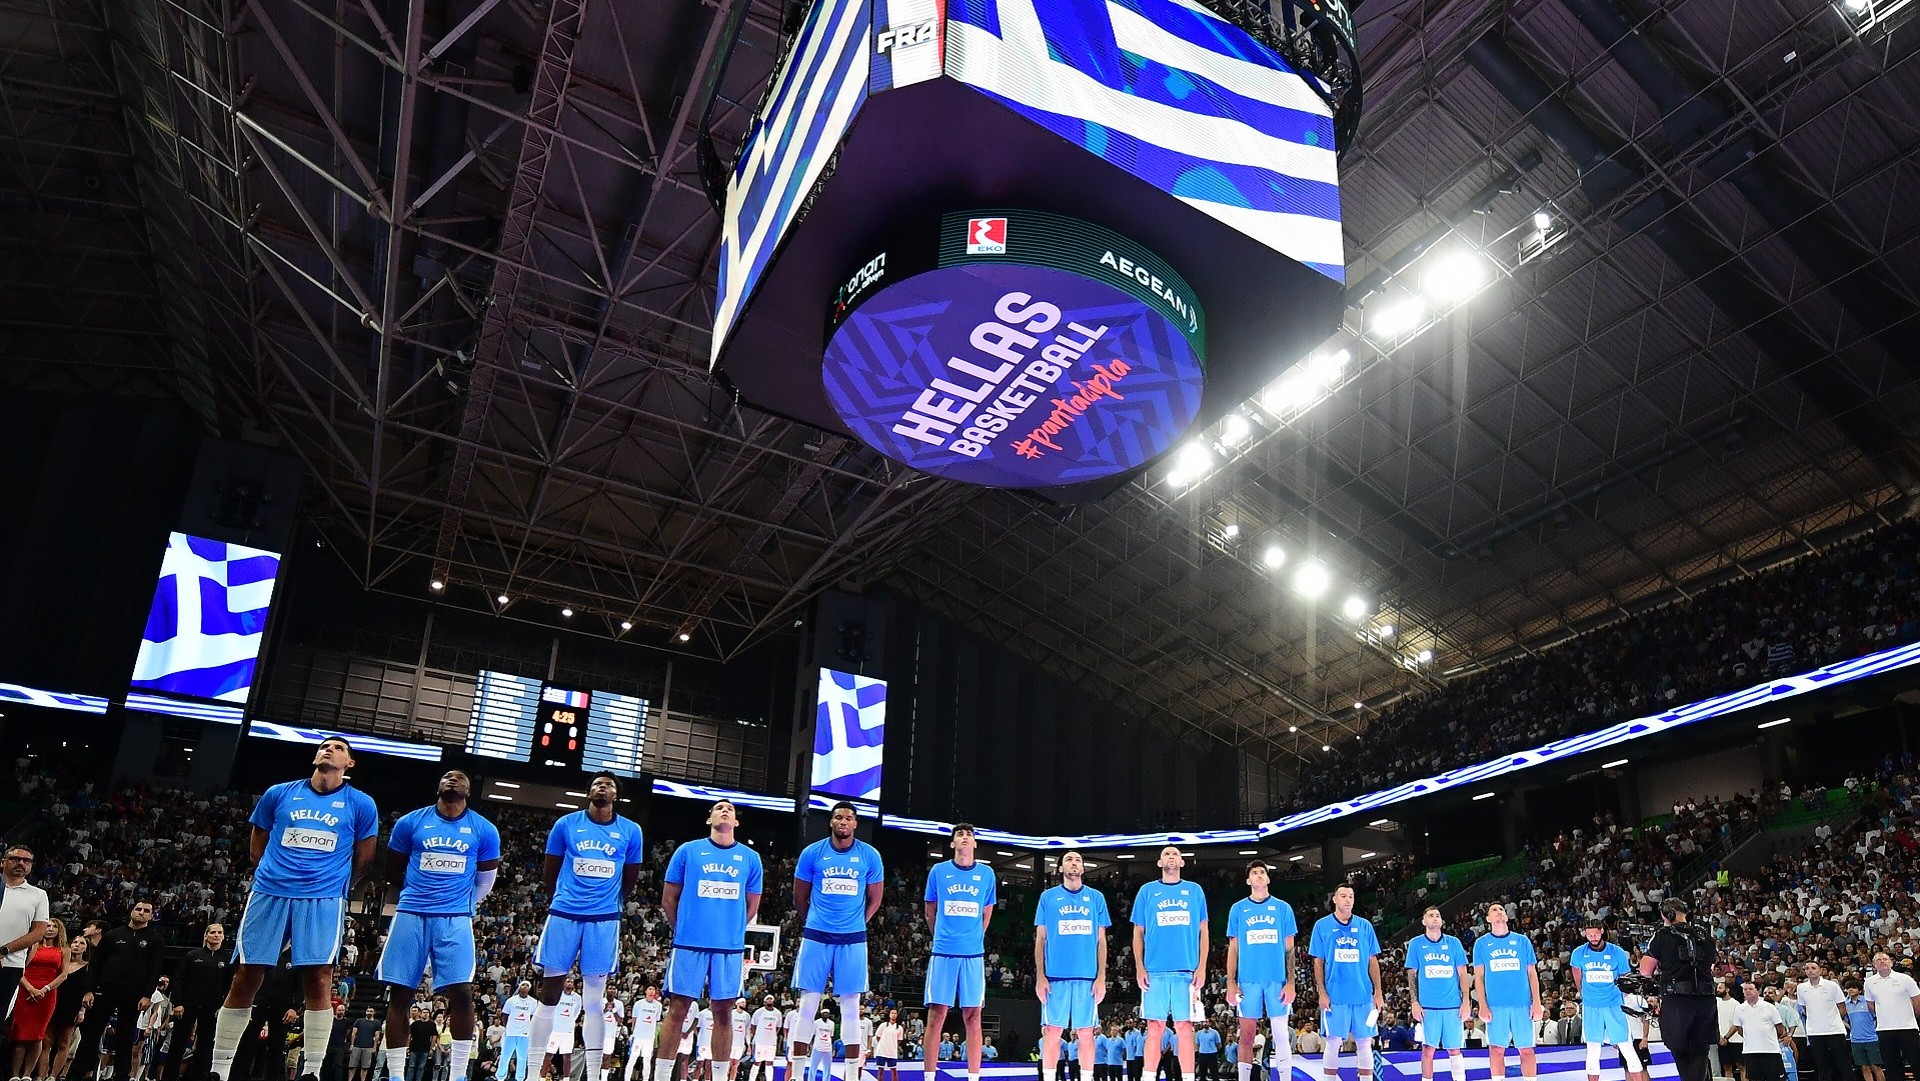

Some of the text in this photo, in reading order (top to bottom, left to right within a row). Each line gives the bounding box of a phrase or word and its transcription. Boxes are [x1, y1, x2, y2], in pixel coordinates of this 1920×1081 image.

[877, 19, 937, 54] FRA
[1099, 250, 1187, 320] AEGEAN
[892, 291, 1062, 447] HELLAS
[948, 321, 1109, 458] BASKETBALL
[552, 710, 575, 724] 4:25
[541, 735, 550, 746] 0
[568, 739, 577, 750] 0
[289, 809, 339, 827] HELLAS
[422, 836, 470, 853] HELLAS
[575, 839, 616, 856] HELLAS
[701, 863, 739, 878] HELLAS
[822, 866, 859, 879] HELLAS
[946, 883, 980, 897] HELLAS
[1058, 904, 1090, 916] HELLAS
[1157, 898, 1189, 910] HELLAS
[1245, 914, 1276, 927] HELLAS
[1423, 952, 1451, 963] HELLAS
[1490, 948, 1518, 958] HELLAS
